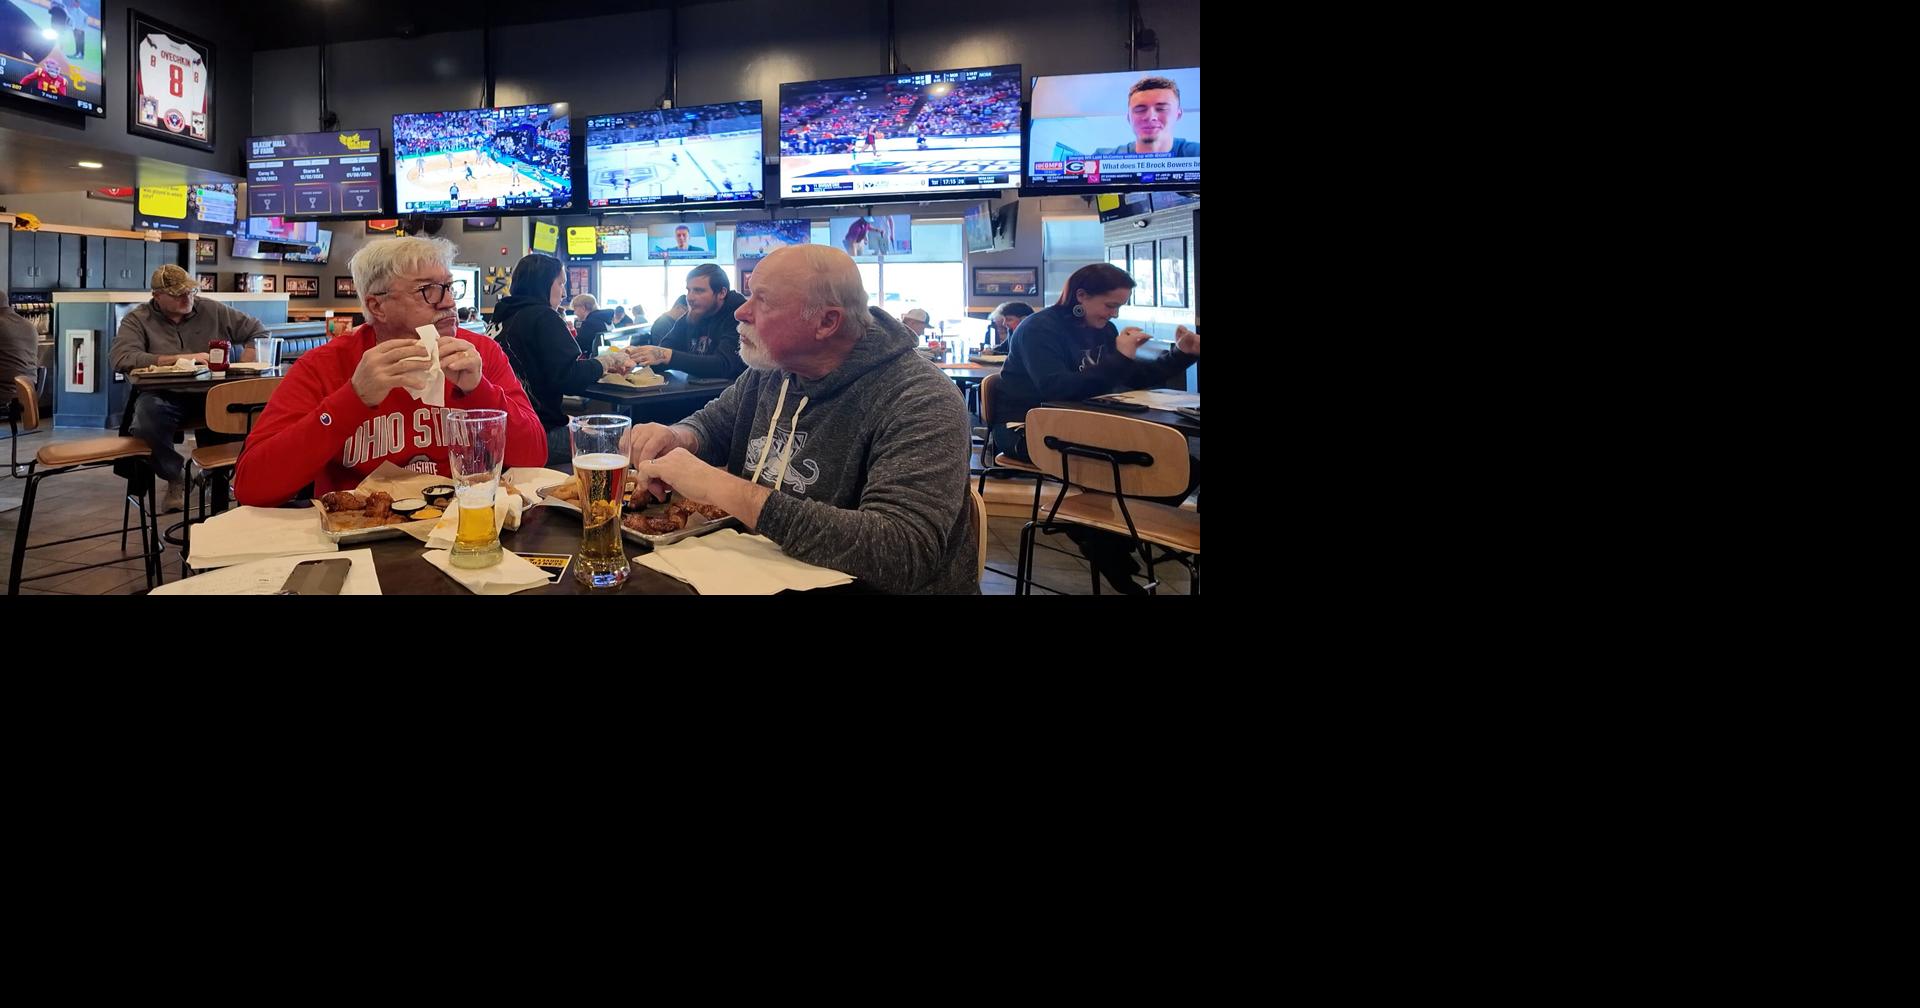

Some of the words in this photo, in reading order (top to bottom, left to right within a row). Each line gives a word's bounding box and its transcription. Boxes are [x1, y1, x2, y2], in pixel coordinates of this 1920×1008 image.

[151, 55, 157, 68] 8
[161, 50, 191, 67] OVECHKIN
[169, 64, 183, 98] 8
[193, 71, 199, 83] 8
[77, 100, 92, 110] FS1
[342, 411, 405, 468] OHIO
[416, 461, 438, 476] STATE
